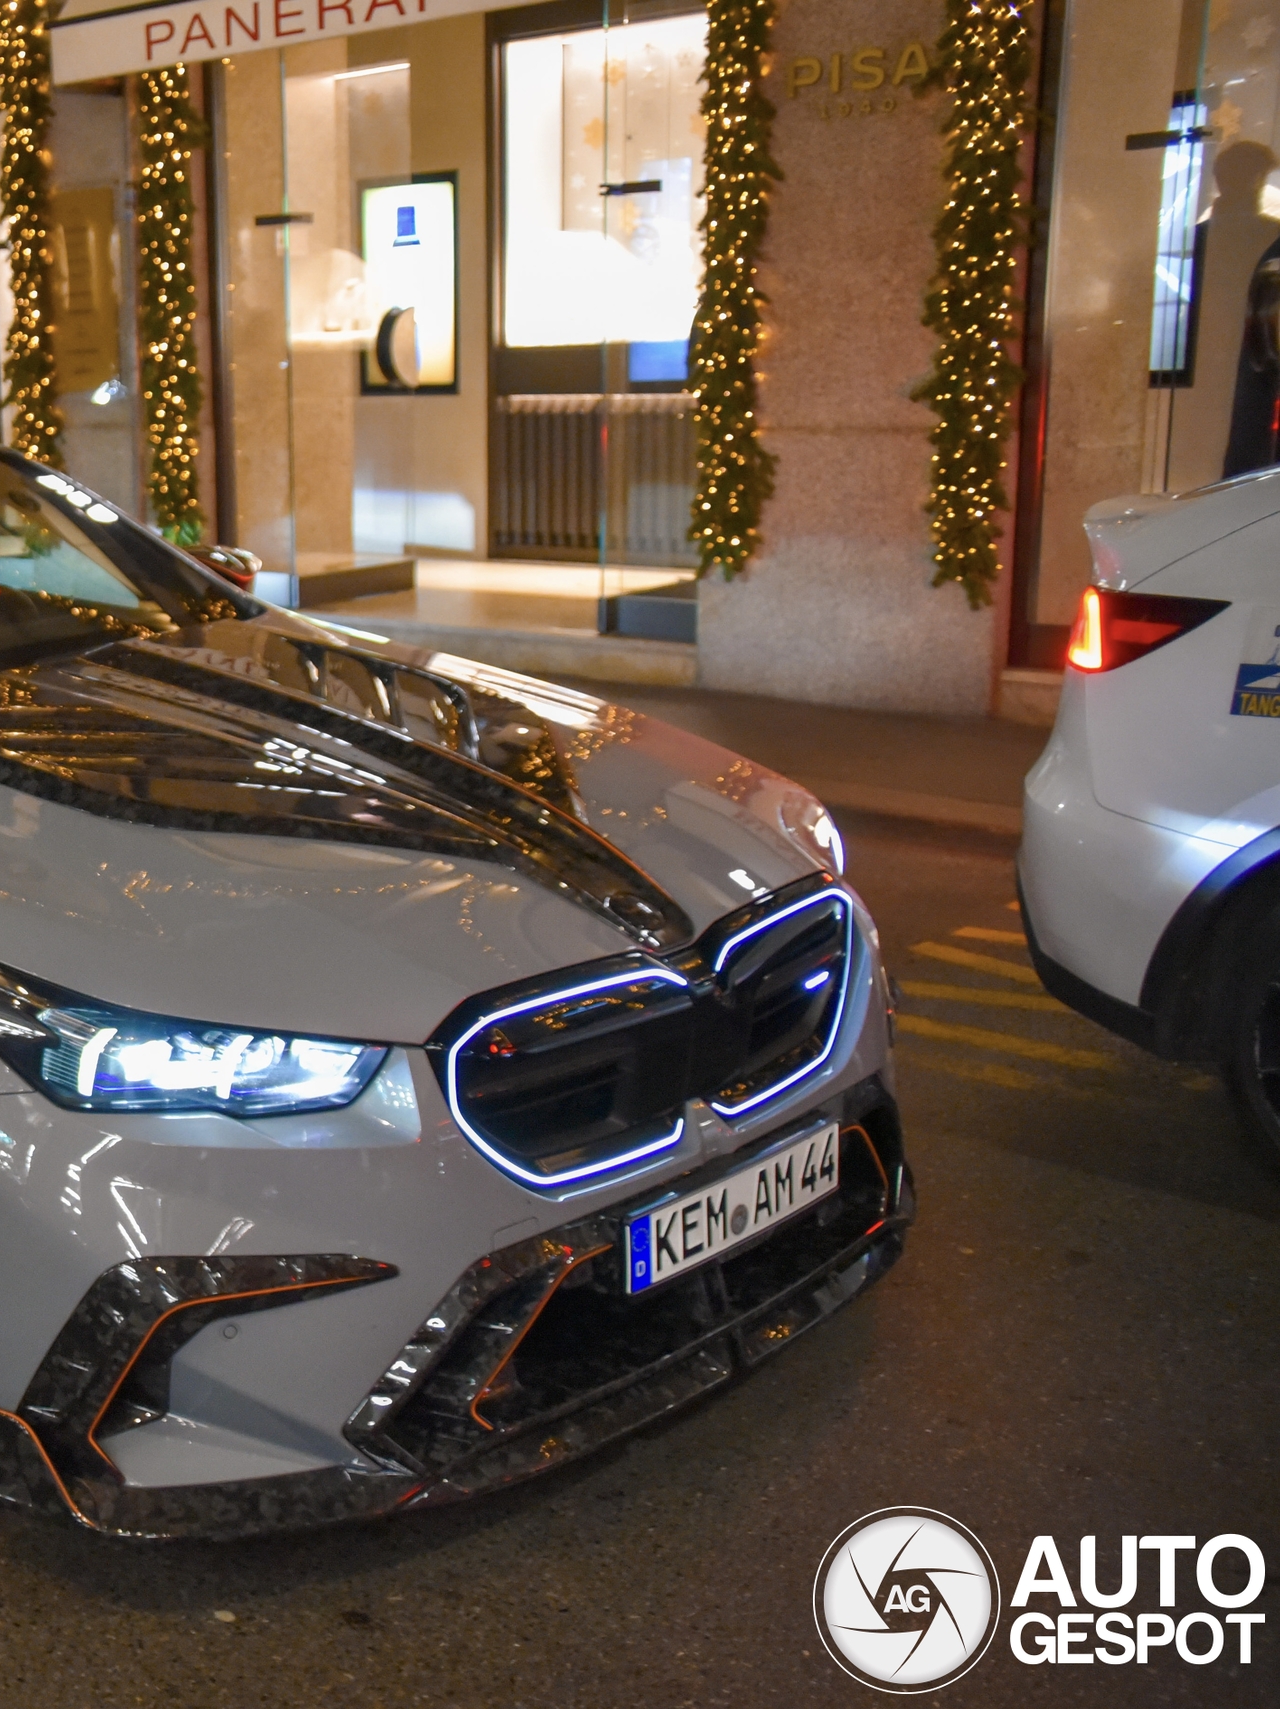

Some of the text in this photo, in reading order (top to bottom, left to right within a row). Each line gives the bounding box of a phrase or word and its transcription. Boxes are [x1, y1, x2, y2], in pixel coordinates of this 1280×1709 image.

[786, 43, 929, 98] PISA
[656, 1132, 834, 1272] KEM AM 44
[635, 1260, 646, 1278] D
